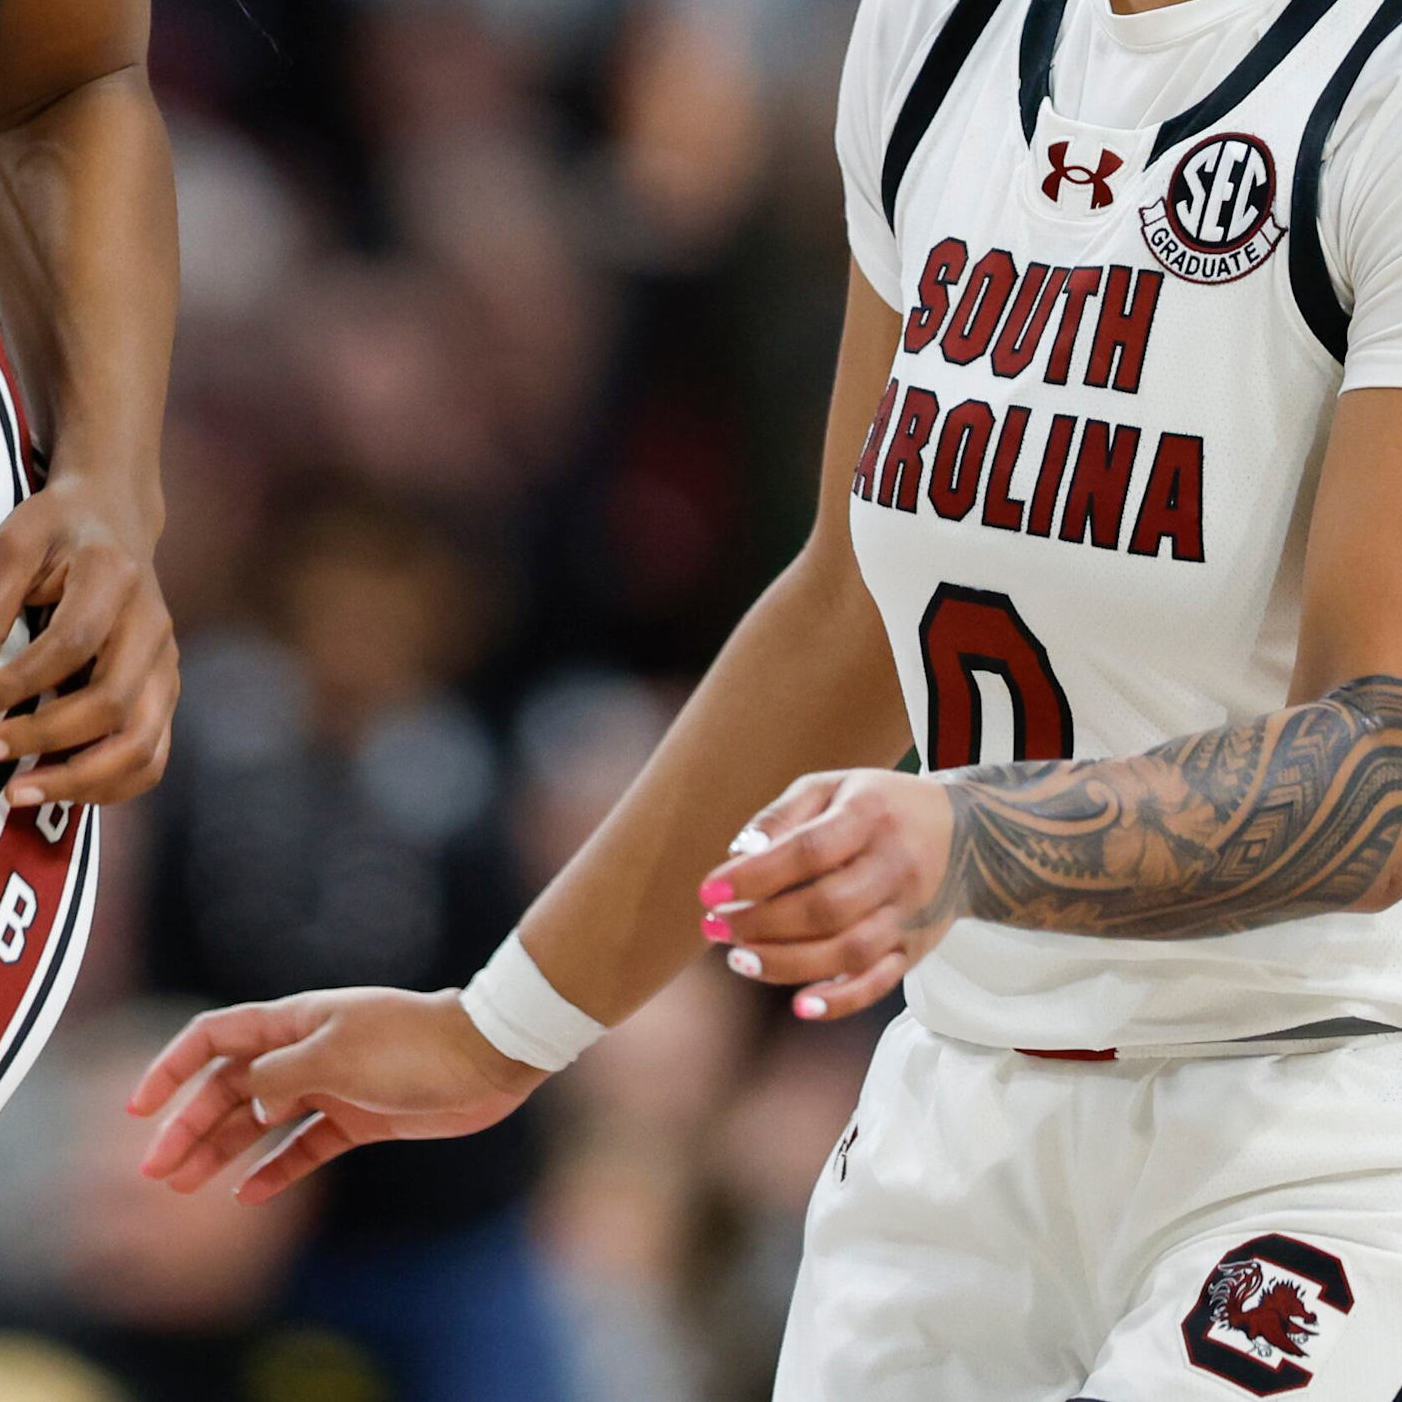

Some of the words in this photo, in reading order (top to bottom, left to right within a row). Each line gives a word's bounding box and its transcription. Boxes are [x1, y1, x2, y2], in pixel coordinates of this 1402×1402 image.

[1149, 225, 1262, 280] GRADUATE
[1174, 141, 1268, 244] SEC
[903, 236, 1166, 394] SOUTH
[852, 377, 1206, 564] AROLINA
[918, 580, 1076, 772] 0
